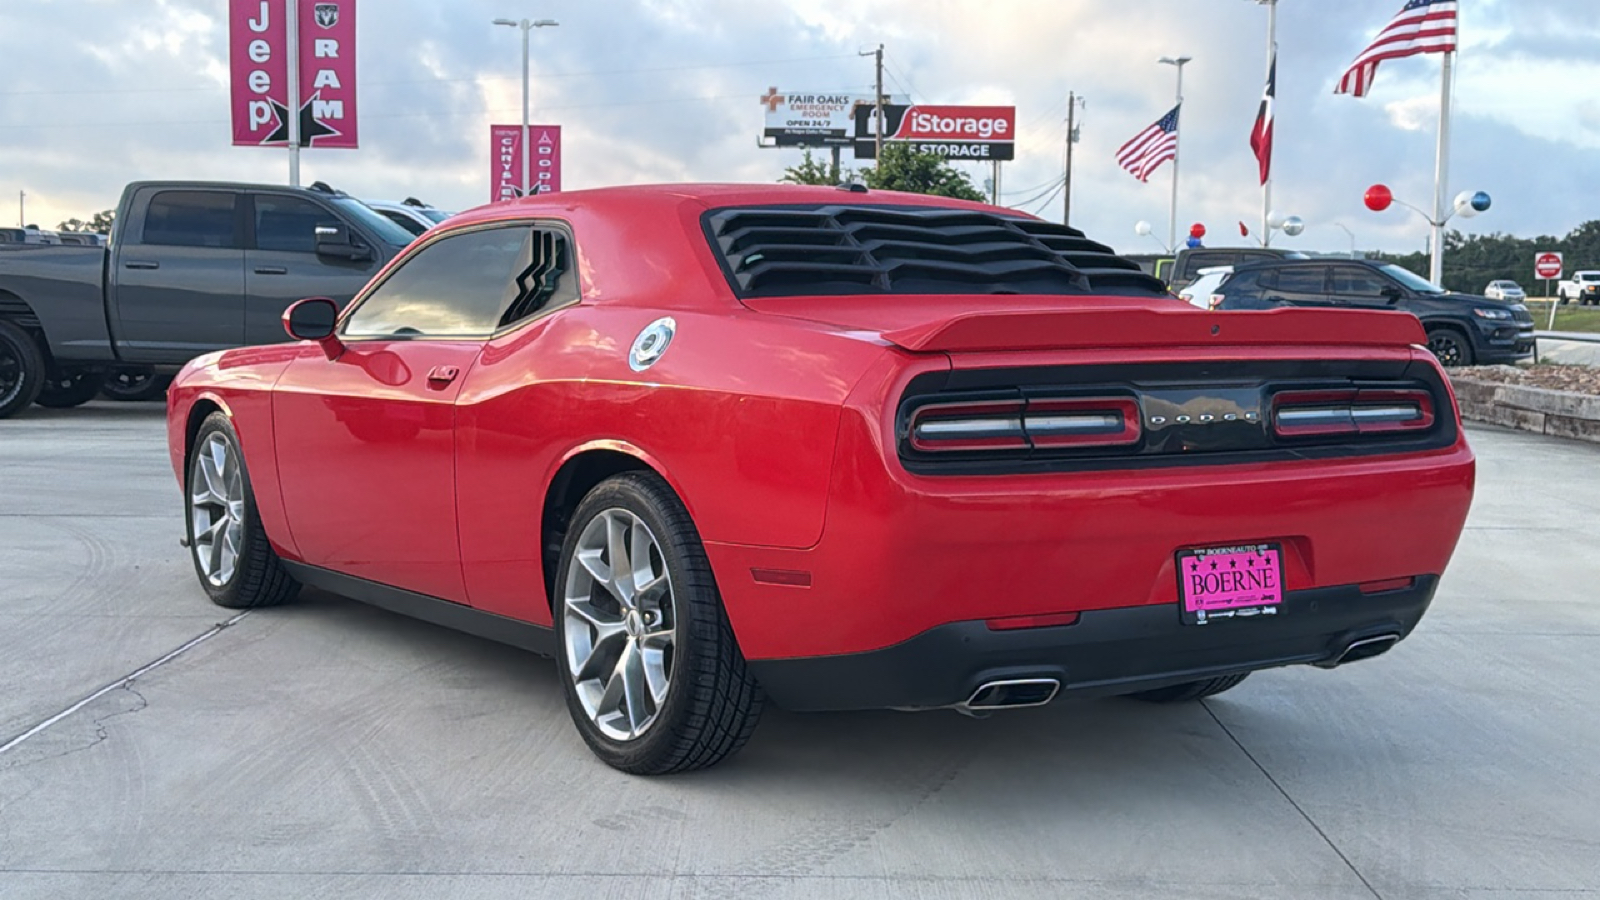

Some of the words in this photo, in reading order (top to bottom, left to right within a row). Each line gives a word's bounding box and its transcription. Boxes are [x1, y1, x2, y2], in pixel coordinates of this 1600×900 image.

[249, 1, 271, 131] Jeep
[312, 39, 344, 120] RAM
[788, 95, 815, 104] FAIR
[817, 95, 849, 105] OAKS
[790, 104, 845, 112] EMERGENCY
[911, 111, 1008, 138] iStorage
[920, 144, 990, 157] STORAGE
[538, 146, 552, 192] DODGE
[1151, 412, 1257, 422] DODGE
[1190, 568, 1276, 596] BOERNE
